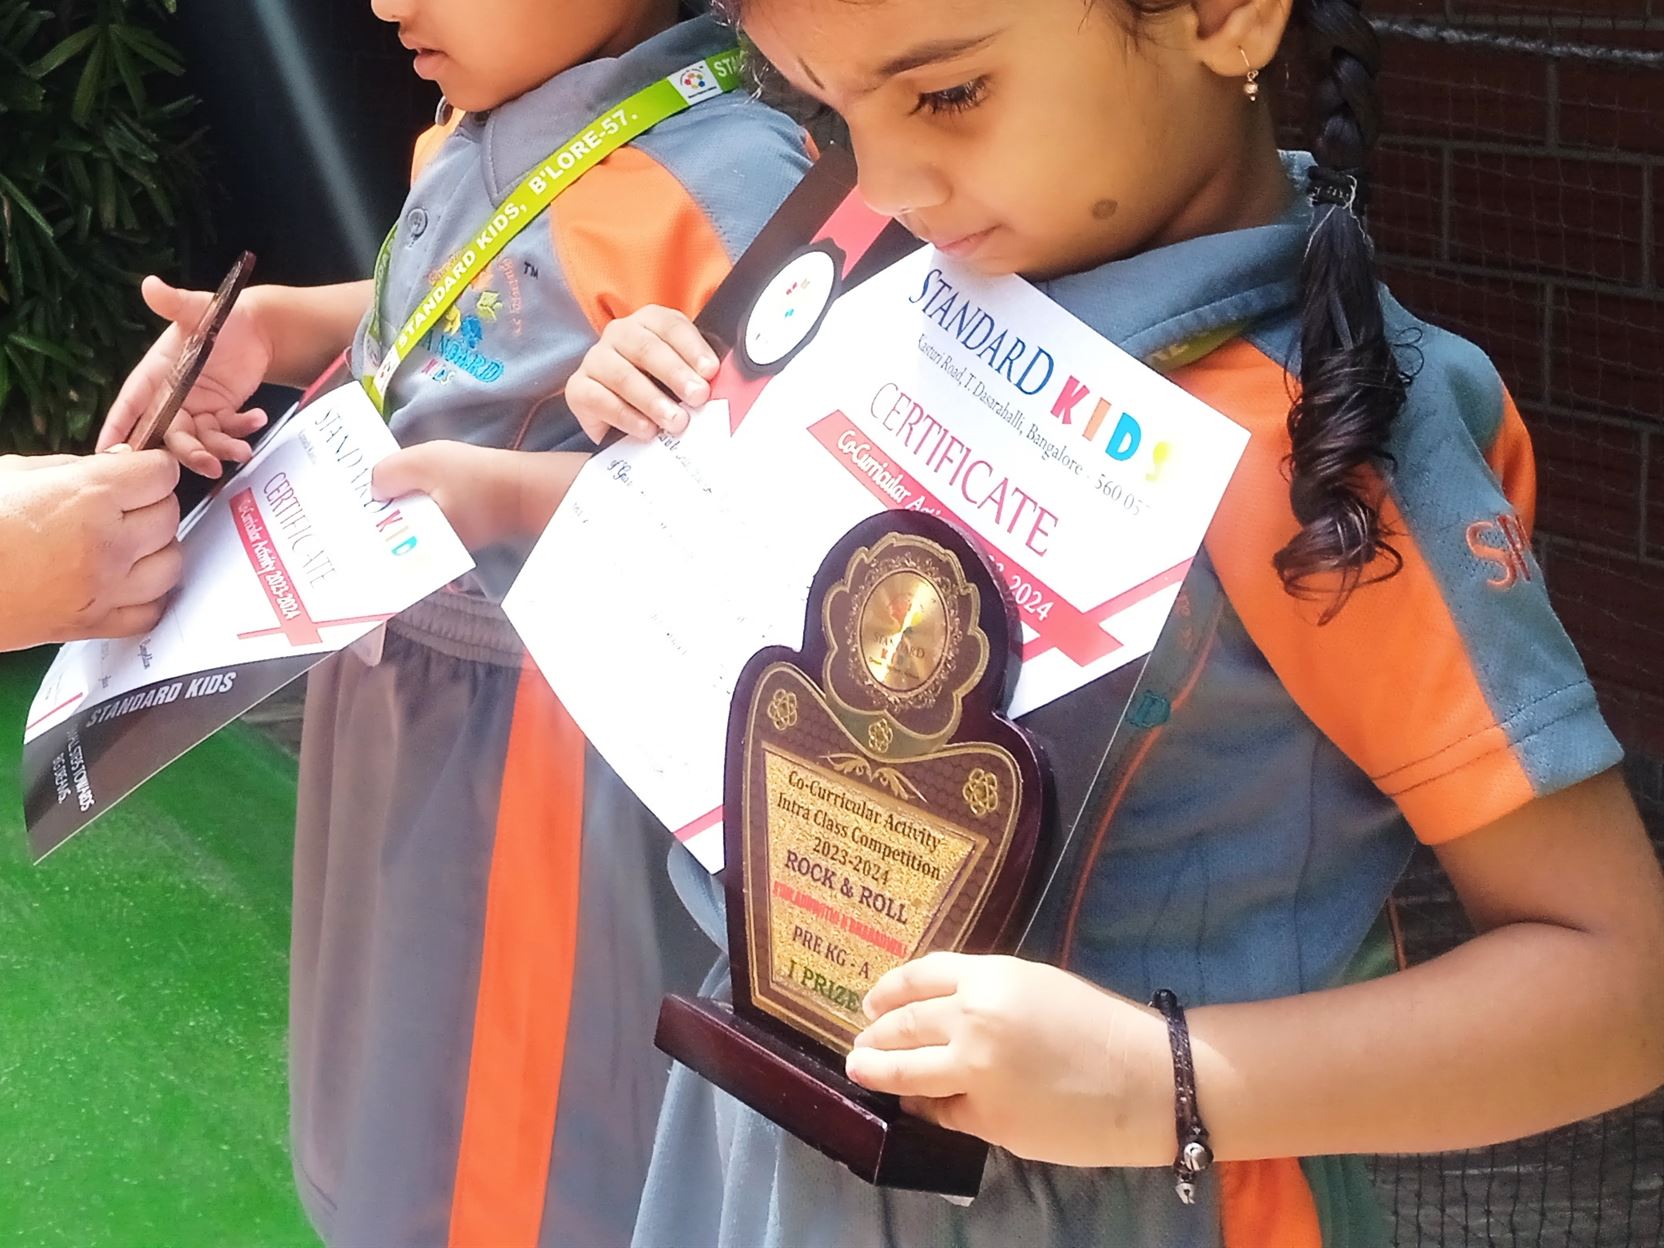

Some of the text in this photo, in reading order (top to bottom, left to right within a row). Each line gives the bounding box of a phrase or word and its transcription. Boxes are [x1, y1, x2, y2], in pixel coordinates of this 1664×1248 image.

[397, 250, 476, 349] STANDARD
[477, 203, 528, 251] KIDS,
[528, 108, 639, 195] B'LORE-57.
[908, 267, 1055, 396] STANDARD
[939, 352, 966, 389] Road,
[1025, 423, 1084, 475] Bangalore
[837, 428, 912, 505] Co-Curricular
[869, 382, 1060, 558] CERTIFICATE
[263, 471, 336, 589] CERTIFICATE
[375, 508, 418, 557] KID
[85, 671, 237, 728] STANDARD KIDS
[777, 791, 942, 882] Intra Class Competition
[788, 770, 942, 853] Co-Curricular Activity
[785, 850, 838, 890] ROCK
[840, 877, 855, 899] &
[858, 884, 909, 926] ROLL
[813, 836, 889, 886] 2023-2024
[787, 959, 862, 1013] I PRIZE
[792, 925, 824, 956] PRE
[825, 942, 848, 968] KG
[858, 961, 870, 980] A
